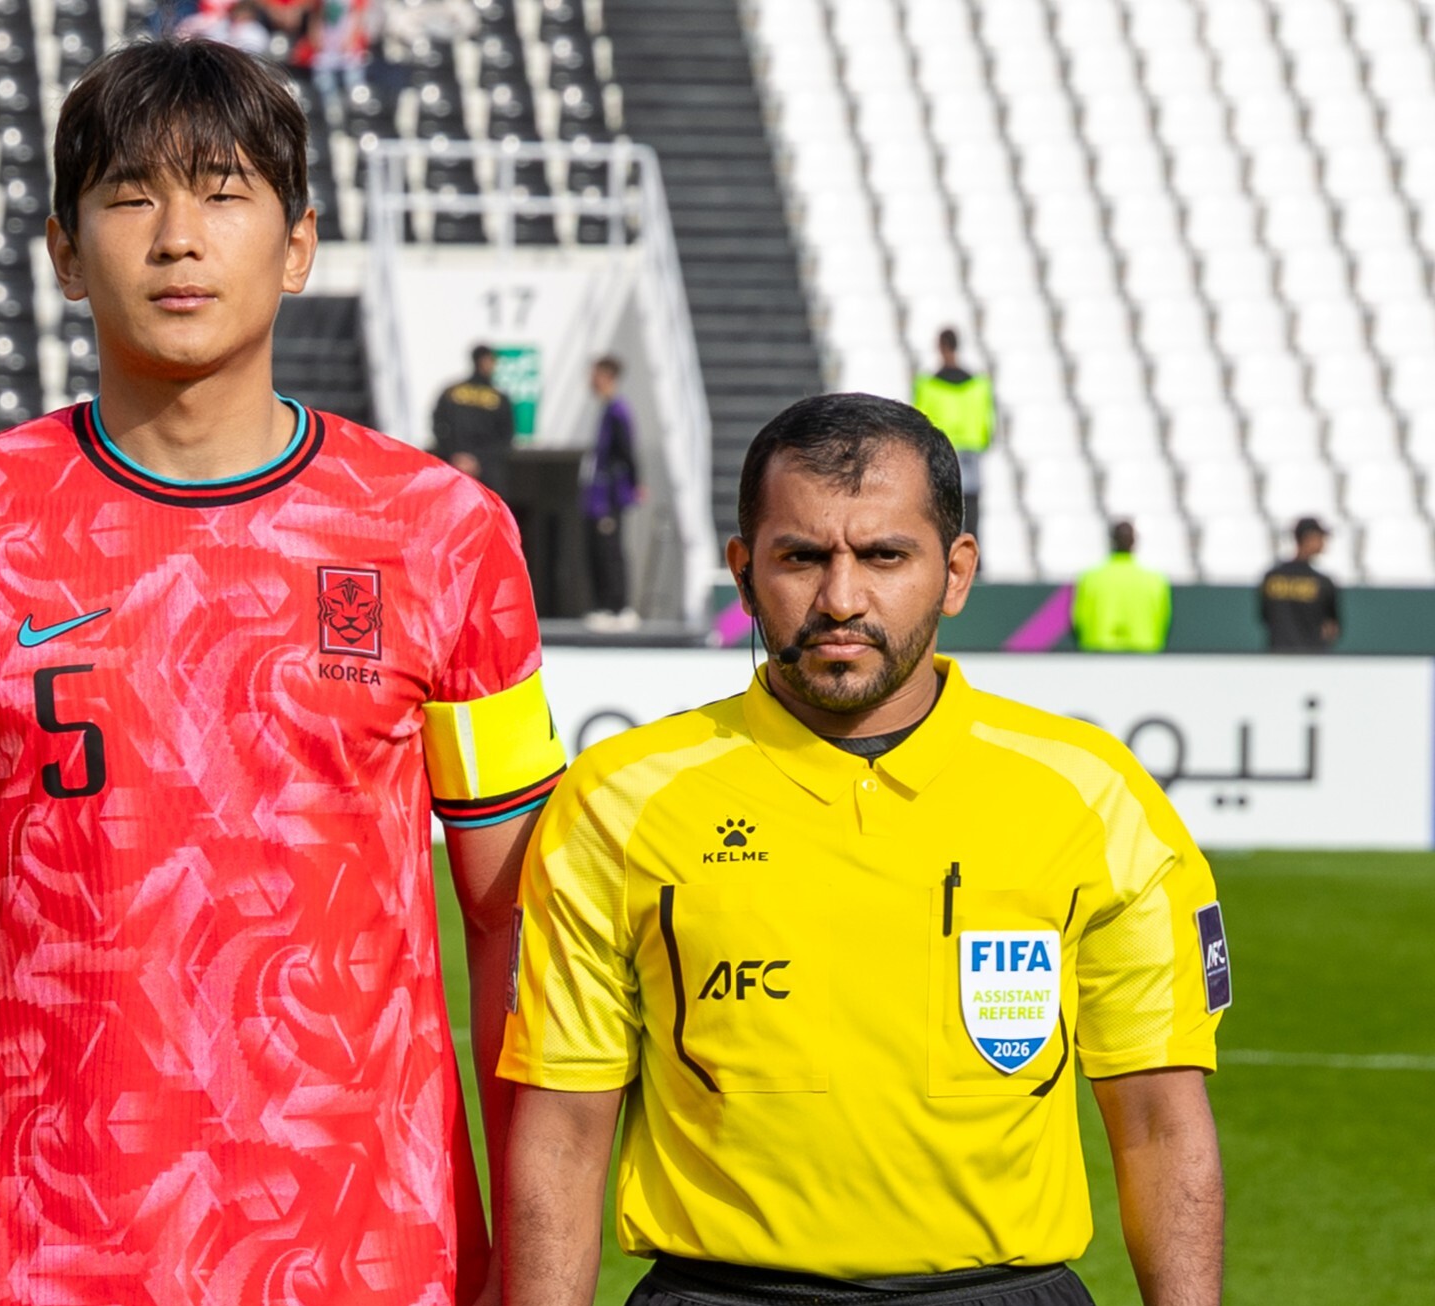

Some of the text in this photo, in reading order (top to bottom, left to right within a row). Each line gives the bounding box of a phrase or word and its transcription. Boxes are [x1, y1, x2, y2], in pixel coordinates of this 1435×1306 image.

[484, 287, 535, 328] 17
[318, 664, 381, 686] KOREA
[33, 663, 107, 799] 5
[702, 851, 769, 864] KELME
[971, 939, 1052, 972] FIFA
[698, 960, 791, 1001] AFC
[972, 988, 1052, 1005] ASSISTANT
[979, 1004, 1045, 1021] REFEREE
[993, 1040, 1030, 1059] 2026
